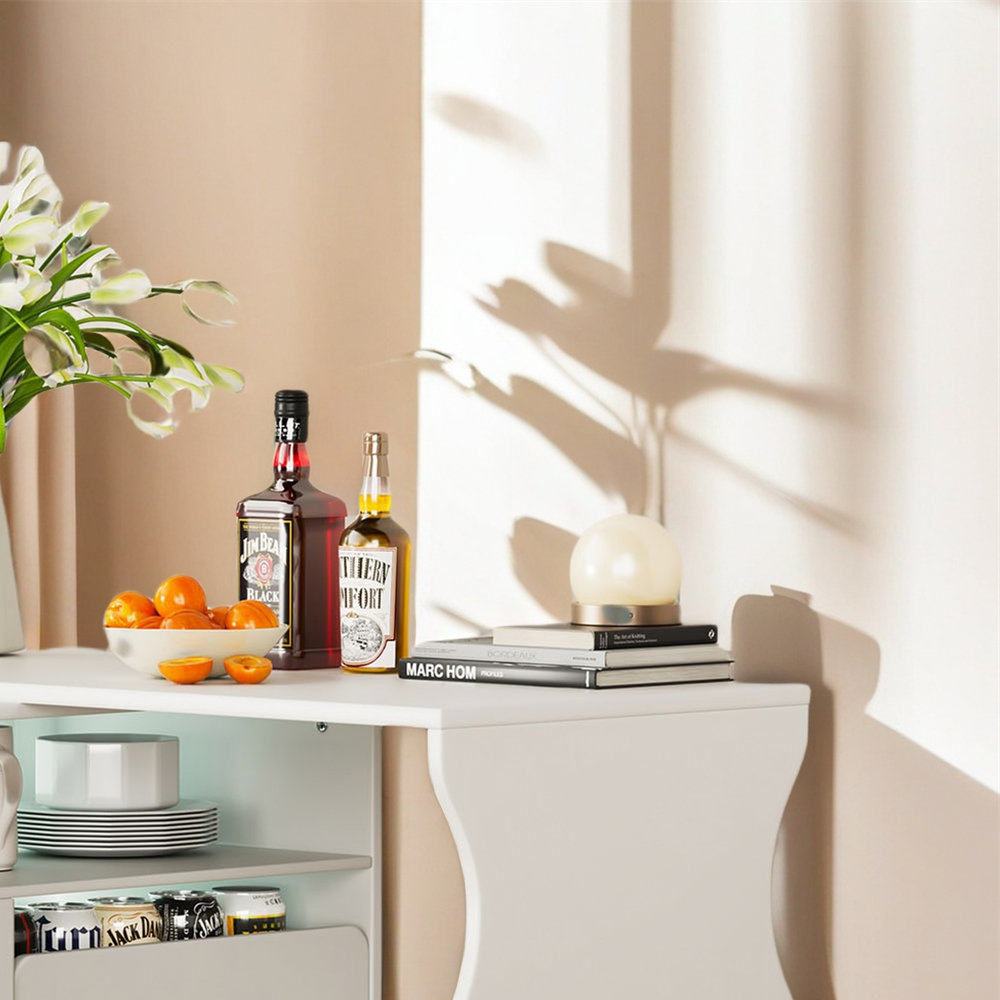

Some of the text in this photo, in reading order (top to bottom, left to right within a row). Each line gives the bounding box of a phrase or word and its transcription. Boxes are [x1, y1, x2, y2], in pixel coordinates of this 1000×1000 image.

[240, 537, 259, 564] JIM
[246, 587, 280, 602] BLACK
[406, 663, 444, 678] MARC
[446, 664, 477, 680] HOM
[107, 922, 141, 947] JACK
[199, 912, 220, 939] JACK
